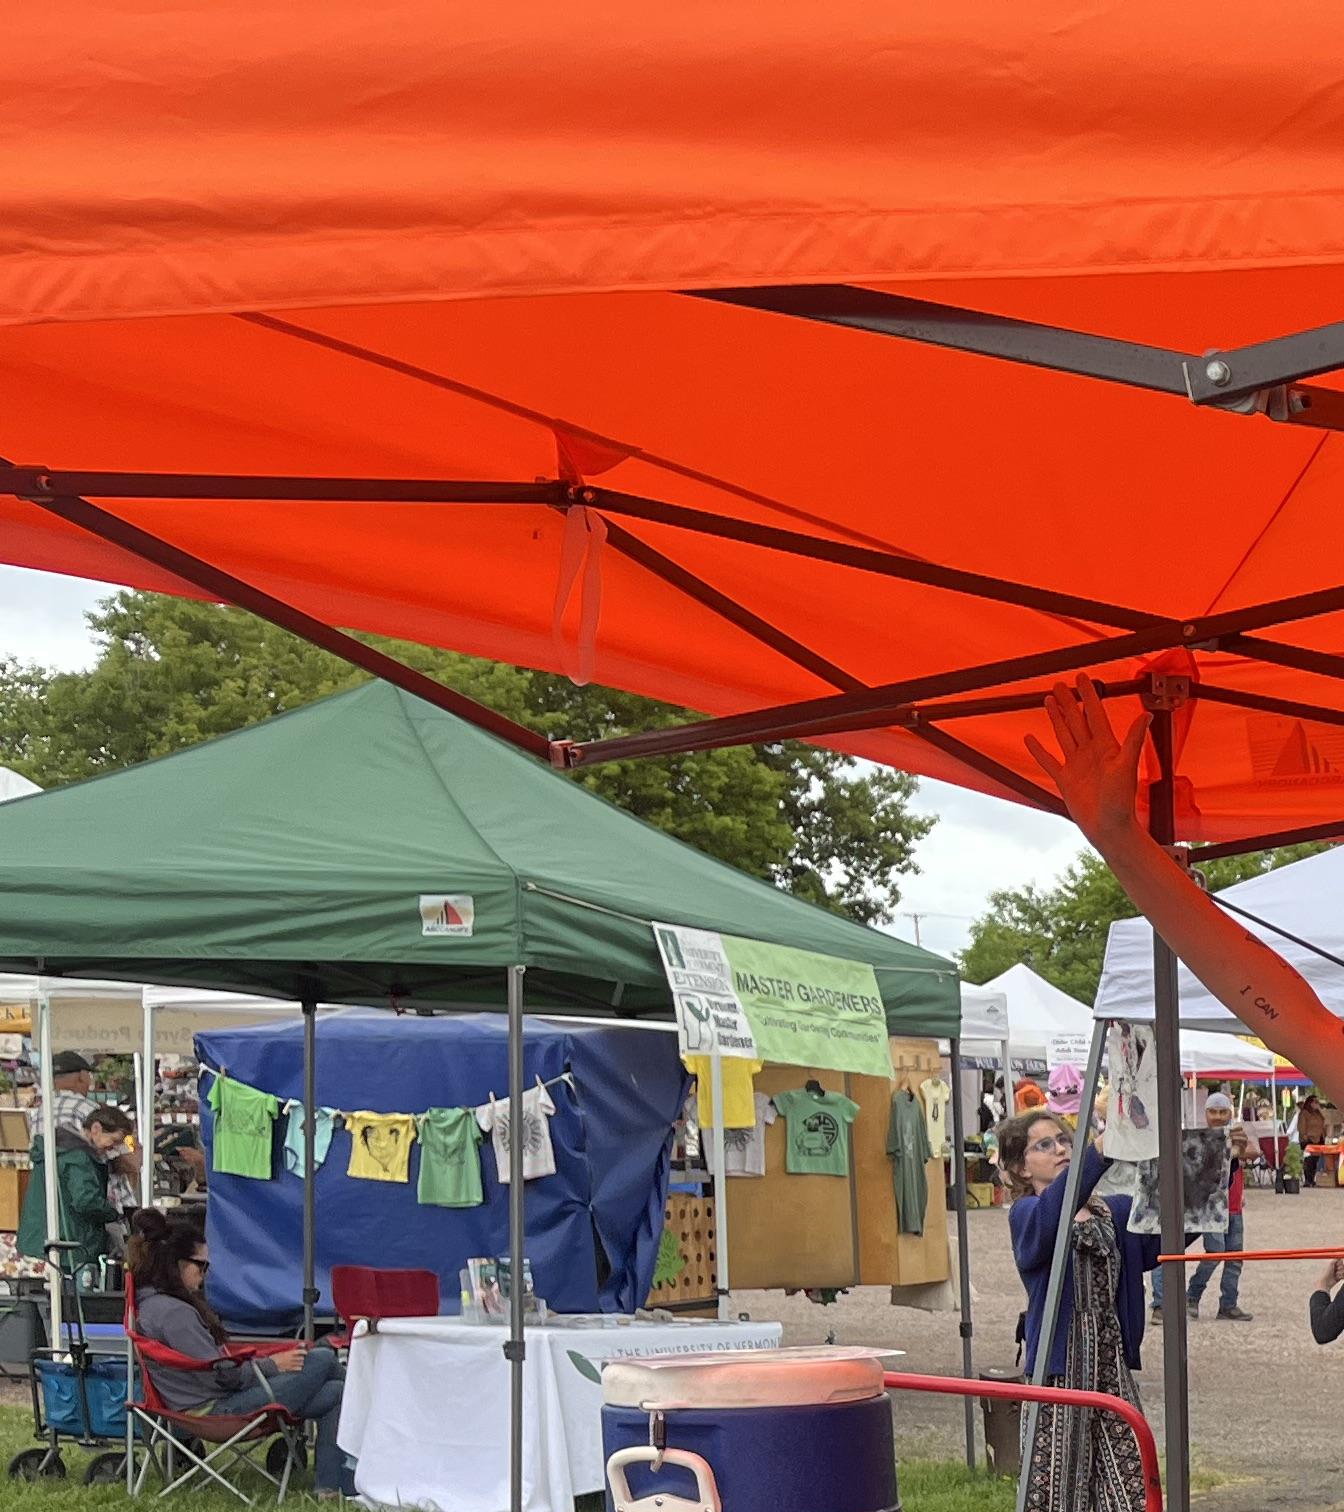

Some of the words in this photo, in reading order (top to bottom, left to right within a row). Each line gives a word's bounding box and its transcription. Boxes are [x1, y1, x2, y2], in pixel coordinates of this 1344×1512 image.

[735, 971, 795, 1001] MASTER
[796, 983, 882, 1016] GARDENERS
[1239, 984, 1252, 995] I
[1254, 996, 1280, 1020] CAN
